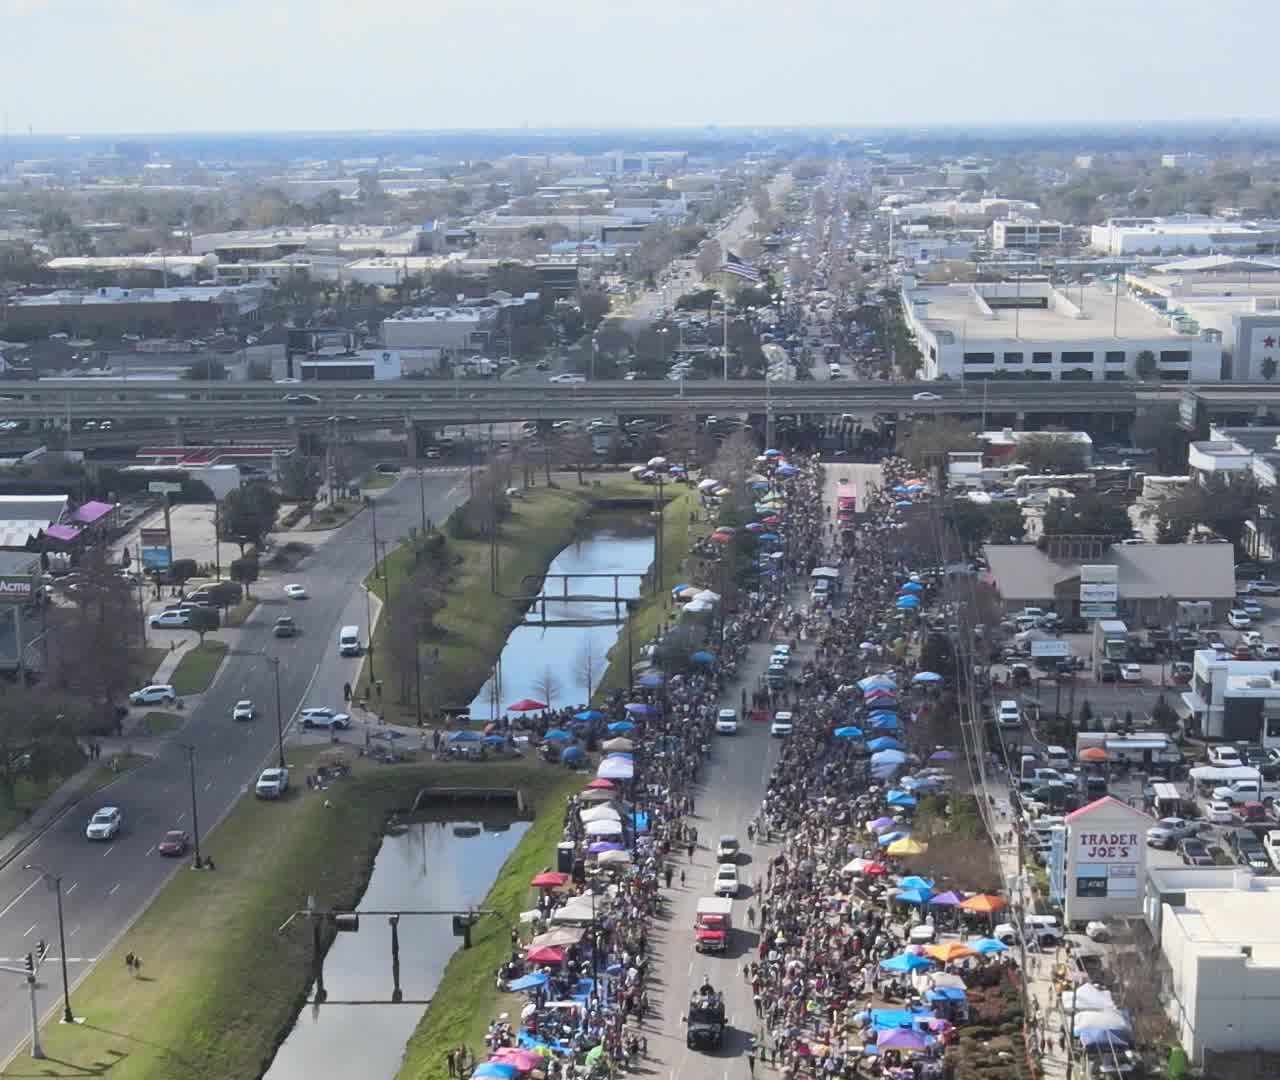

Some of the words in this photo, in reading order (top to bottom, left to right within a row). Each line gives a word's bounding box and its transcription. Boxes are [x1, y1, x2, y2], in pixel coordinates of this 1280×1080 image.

[0, 580, 31, 591] Acme
[1080, 834, 1137, 846] TRADER
[1088, 847, 1129, 858] JOE'S
